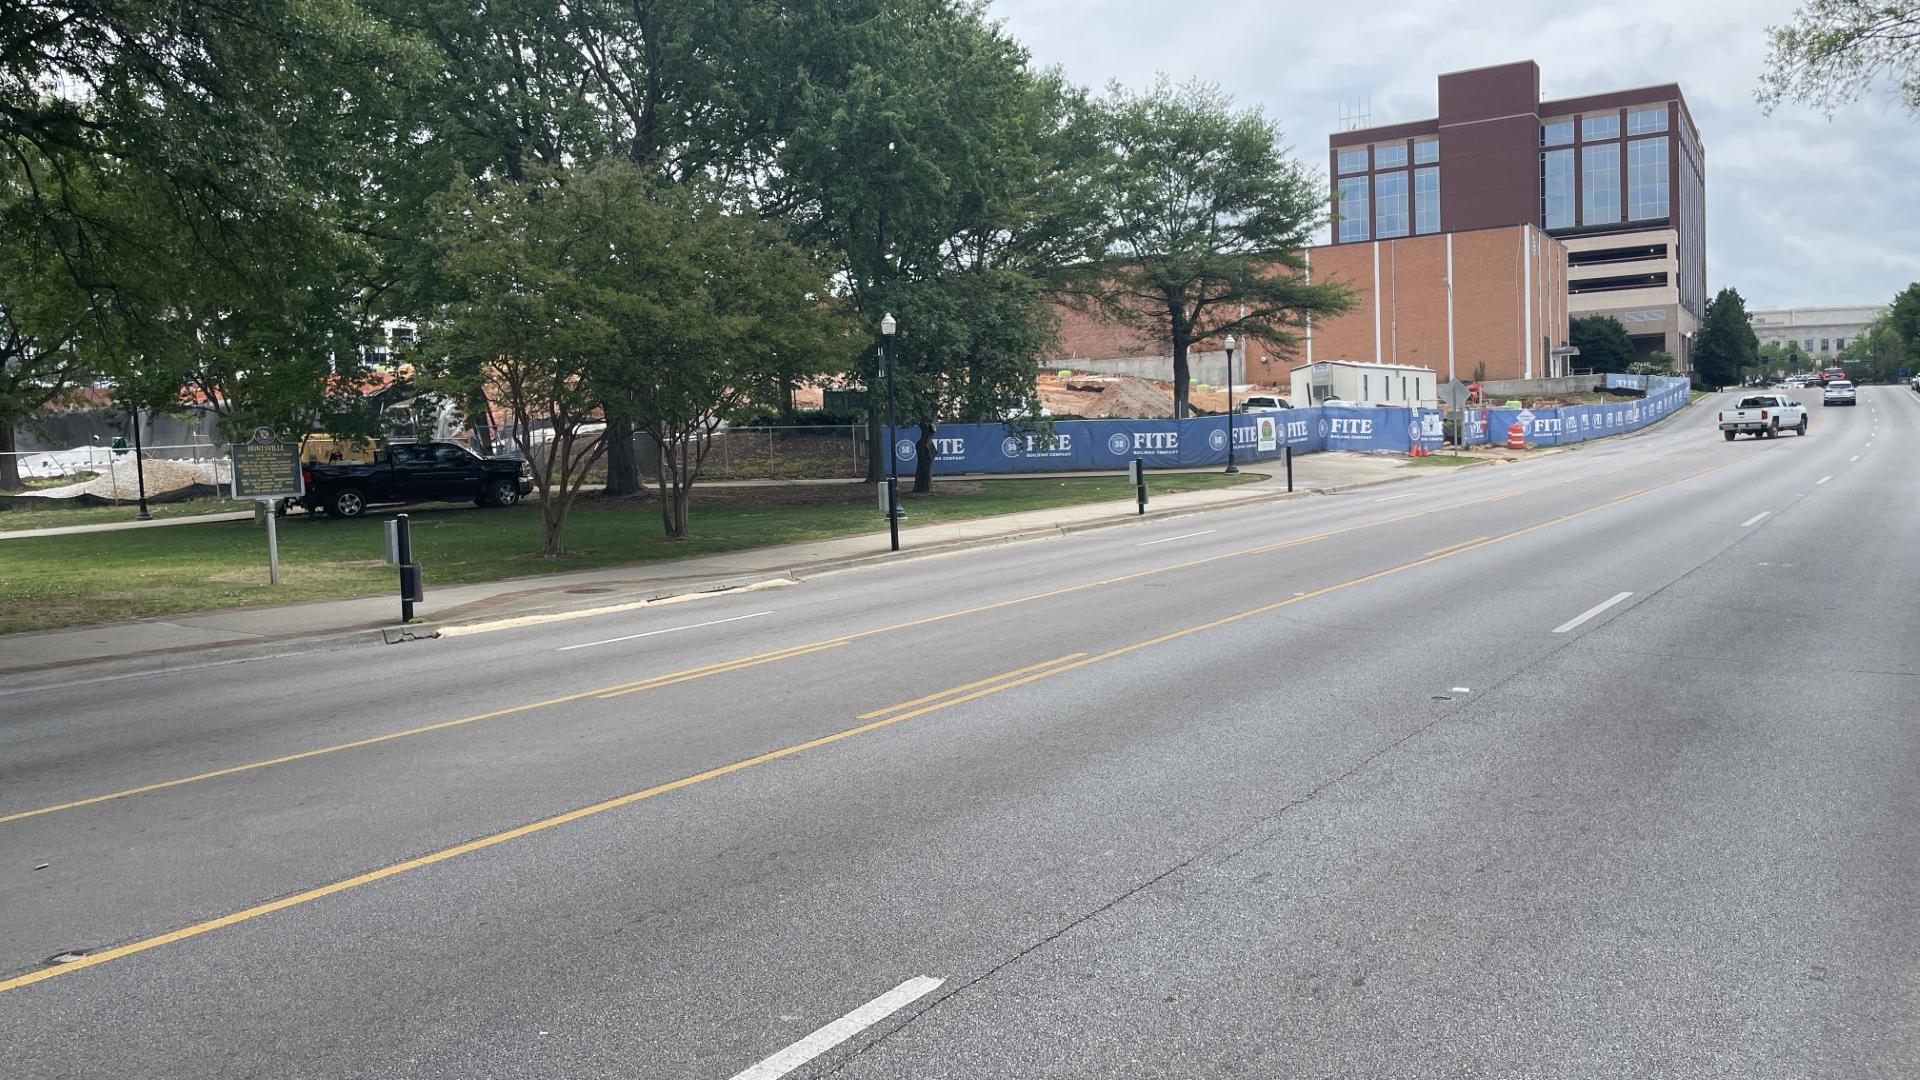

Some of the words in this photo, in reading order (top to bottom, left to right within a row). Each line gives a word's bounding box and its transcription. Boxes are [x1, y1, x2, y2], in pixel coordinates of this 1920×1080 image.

[1287, 420, 1308, 438] FITE
[1331, 418, 1373, 434] FITE
[247, 444, 285, 452] HUNTSVILLE
[1133, 432, 1179, 449] FITE
